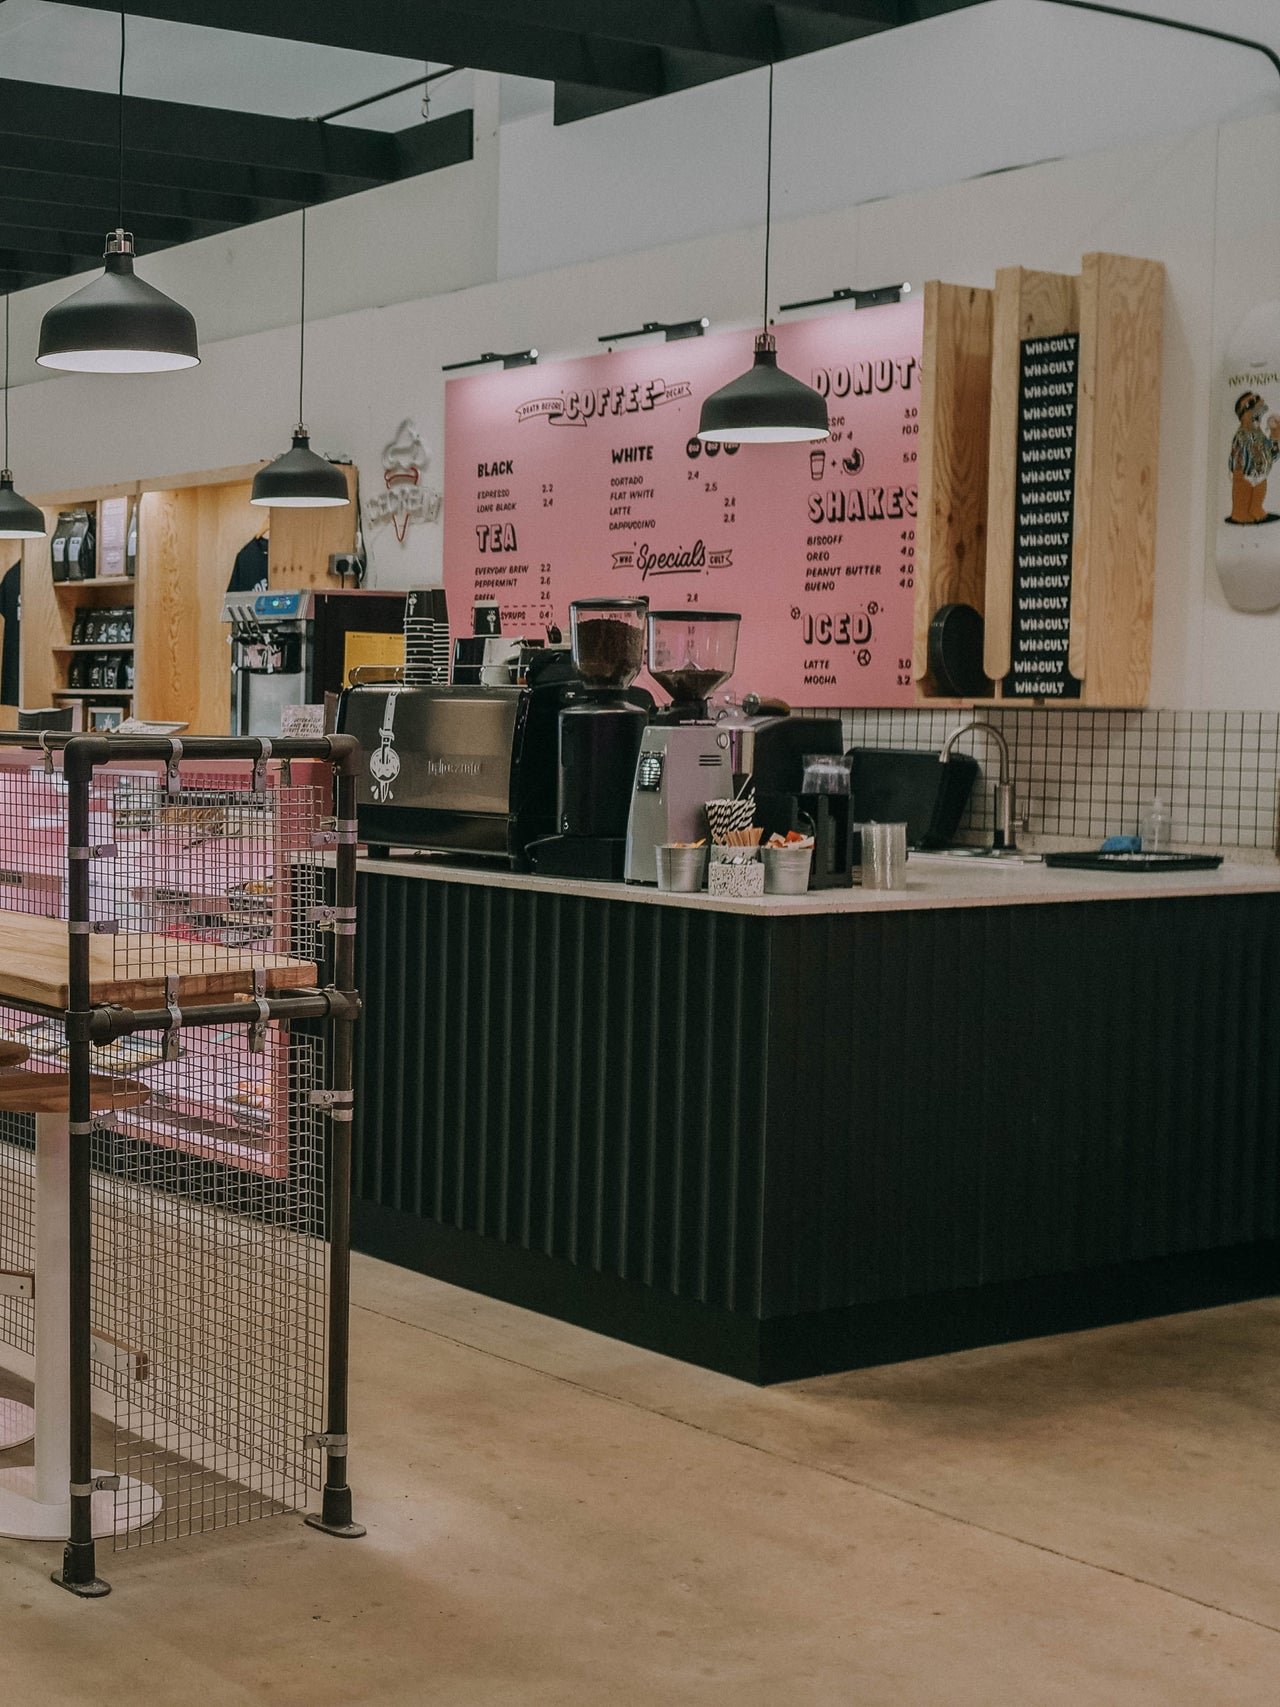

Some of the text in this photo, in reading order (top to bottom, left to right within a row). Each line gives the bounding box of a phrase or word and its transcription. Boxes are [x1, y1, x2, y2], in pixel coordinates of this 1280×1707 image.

[565, 380, 656, 420] COFFEE
[612, 445, 654, 464] WHITE
[477, 460, 514, 478] BLACK
[687, 470, 700, 480] 2.4
[610, 476, 644, 487] CORTADO
[477, 489, 510, 499] ESPRESSO
[610, 489, 654, 500] FLAT WHITE
[477, 502, 517, 513] LONG BLACK
[808, 484, 918, 524] SHAKES
[609, 506, 632, 516] LATTE
[608, 519, 656, 531] CAPPUCCINO
[475, 522, 518, 553] TEA
[806, 535, 843, 546] BISCOFF
[636, 539, 706, 581] Specials
[806, 551, 830, 561] OREO
[475, 565, 529, 575] EVERYDAY BREW
[806, 565, 881, 577] PEANUT BUTTER
[474, 578, 518, 588] PEPPERMINT
[804, 581, 835, 591] BUENO
[500, 611, 526, 620] SYRUPS
[803, 612, 872, 645] ICED
[804, 659, 830, 669] LATTE
[804, 675, 837, 685] MOCHA
